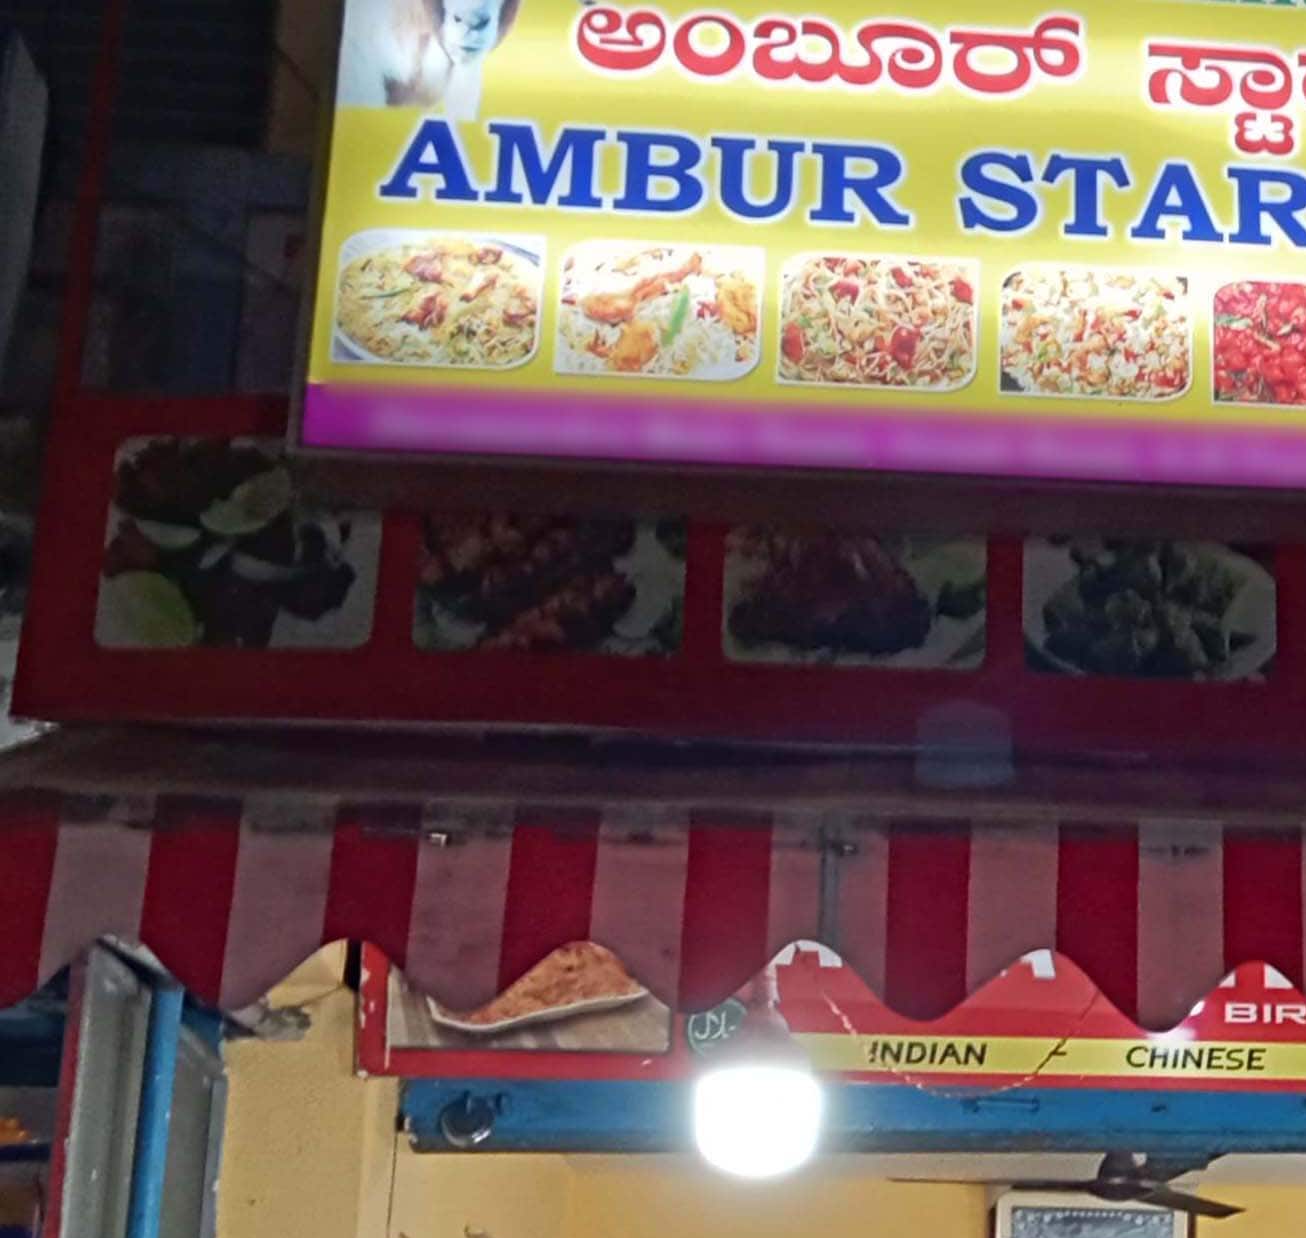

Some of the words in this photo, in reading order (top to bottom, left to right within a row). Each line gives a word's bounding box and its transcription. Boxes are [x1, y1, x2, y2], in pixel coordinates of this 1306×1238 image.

[577, 8, 1081, 94] ಅಂಬೂರ್
[379, 118, 911, 227] AMBUR
[868, 1040, 988, 1066] INDIAN
[1125, 1045, 1267, 1071] CHINESE
